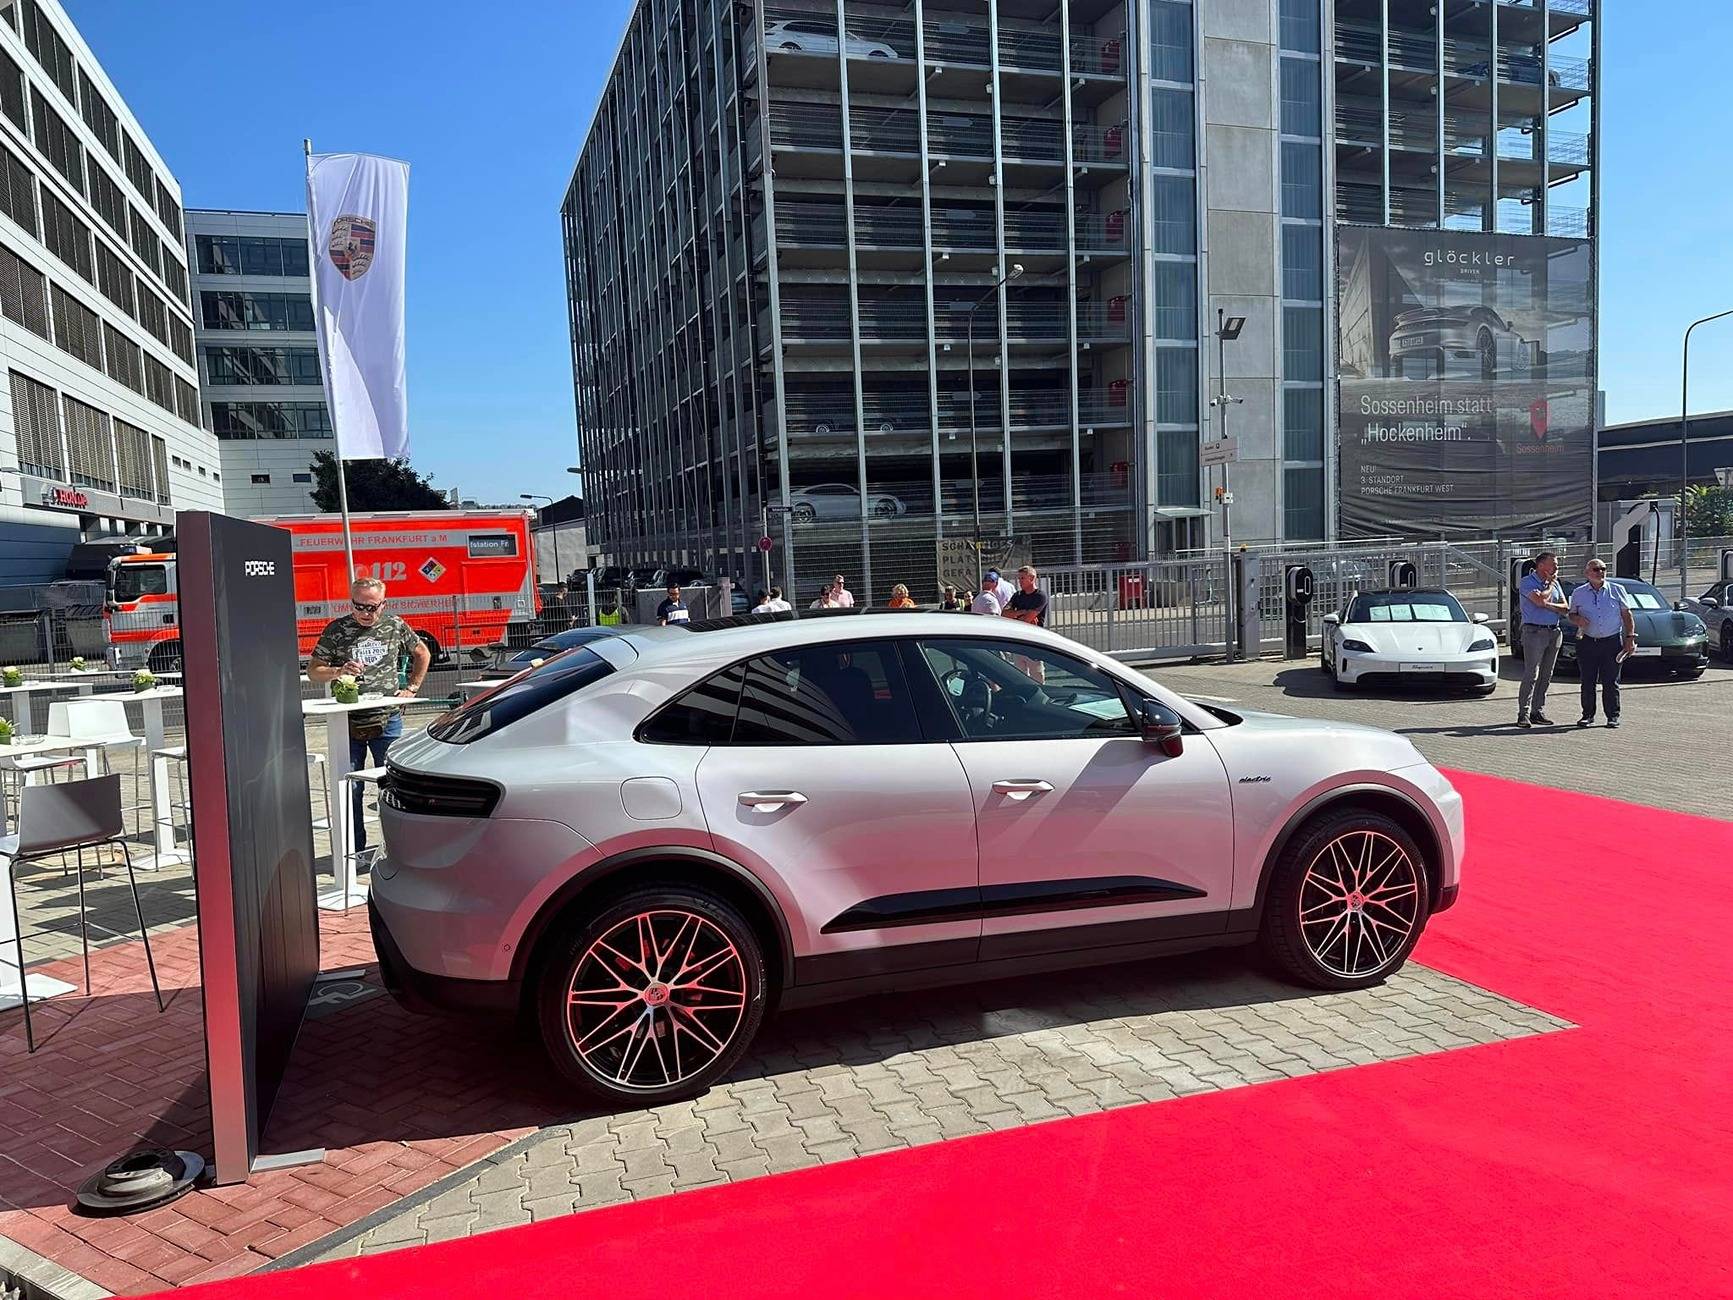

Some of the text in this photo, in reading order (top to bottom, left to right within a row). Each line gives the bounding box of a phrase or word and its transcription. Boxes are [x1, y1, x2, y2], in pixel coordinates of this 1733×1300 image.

[1424, 249, 1514, 266] glöckler
[1360, 395, 1492, 415] Sossenheim statt
[1360, 486, 1393, 495] PORSCHE
[1436, 484, 1454, 493] WEST
[300, 536, 365, 547] FEUERWHR
[368, 535, 429, 544] FRANKFURT
[245, 560, 275, 576] PORSCHE
[372, 561, 407, 581] 112
